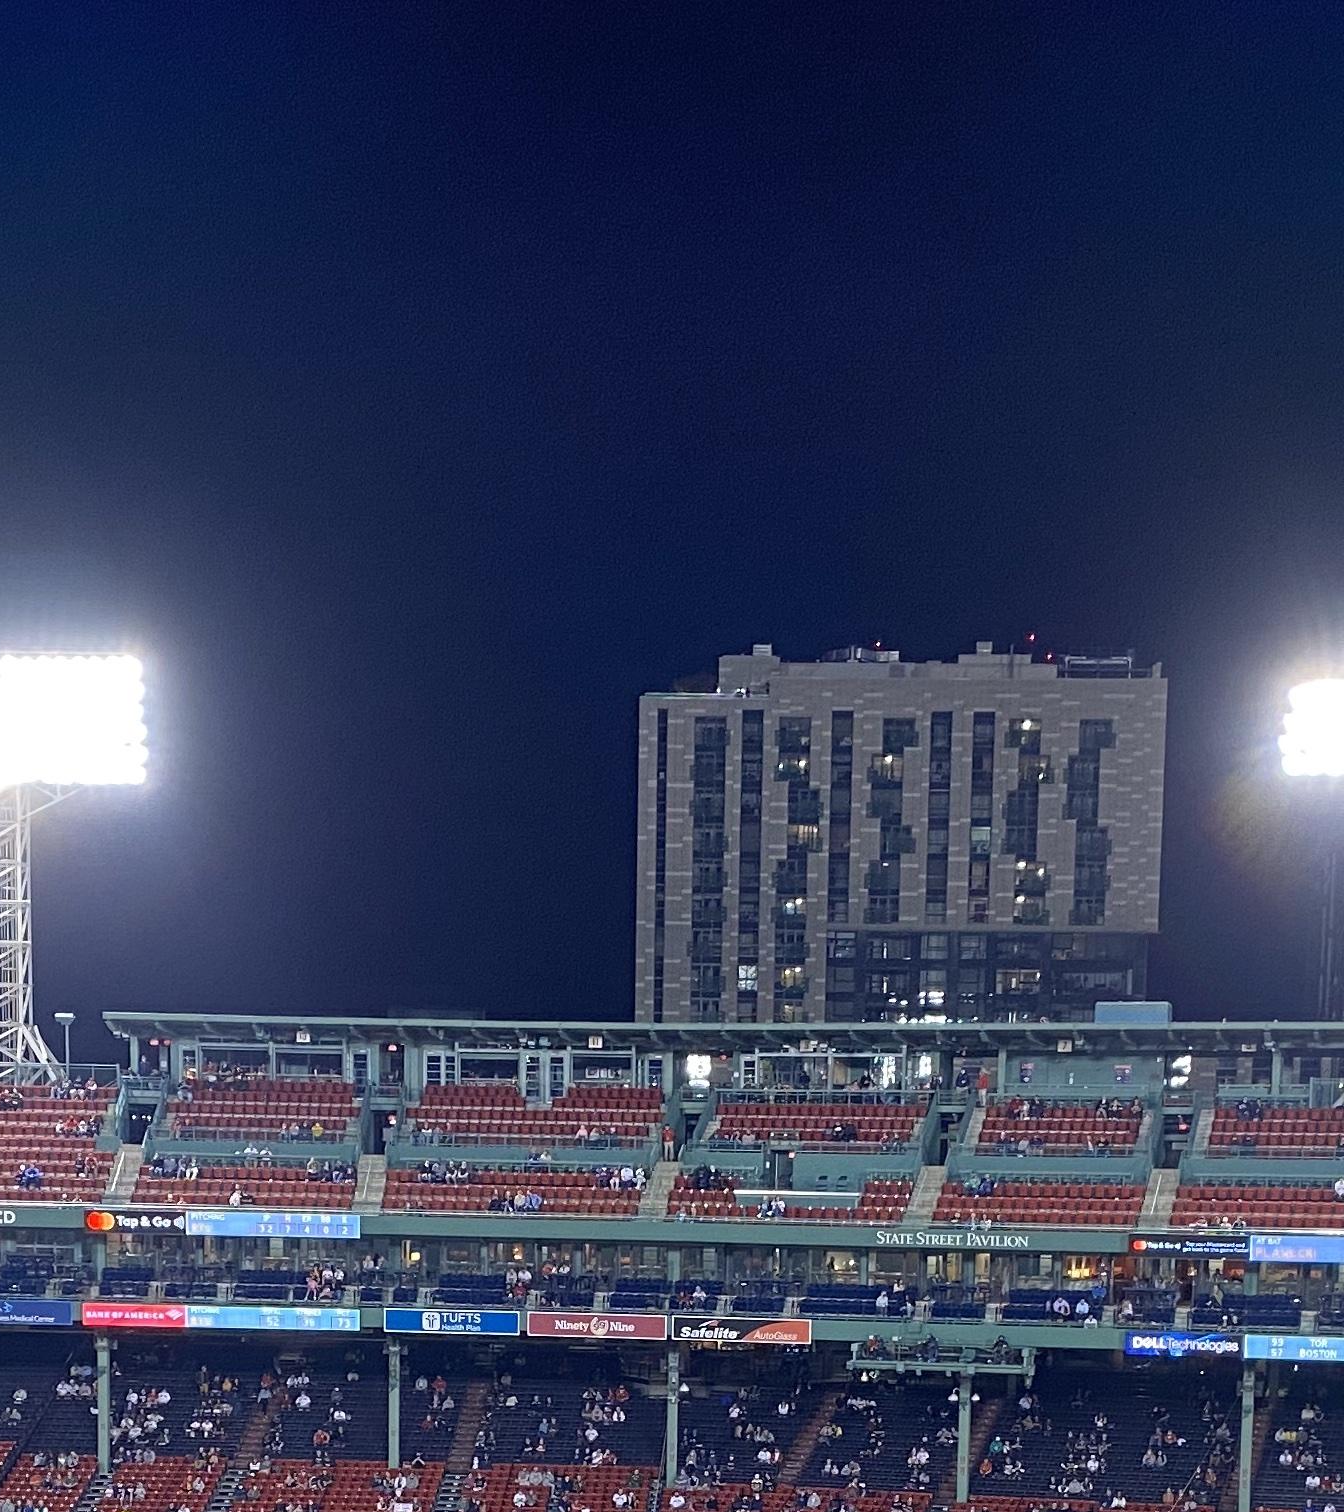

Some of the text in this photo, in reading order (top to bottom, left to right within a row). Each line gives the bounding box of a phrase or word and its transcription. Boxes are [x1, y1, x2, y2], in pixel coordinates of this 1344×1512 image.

[116, 1215, 172, 1229] Tap & Go
[341, 1227, 348, 1235] 2
[876, 1231, 1029, 1247] STATE STREET PAVILION
[10, 1314, 33, 1323] Medical
[34, 1315, 55, 1323] Center
[86, 1310, 164, 1320] BANK OF AMERICA
[441, 1312, 481, 1324] TUFTS
[266, 1318, 351, 1328] 52 73
[441, 1323, 481, 1332] Health Plan
[554, 1319, 635, 1332] Ninety Nine
[680, 1326, 739, 1340] Safelite
[753, 1330, 798, 1341] AutoGlass
[1167, 1337, 1240, 1354] Technologies
[1310, 1339, 1328, 1348] TOR
[1271, 1348, 1283, 1357] 57
[1299, 1348, 1337, 1359] BOSTON
